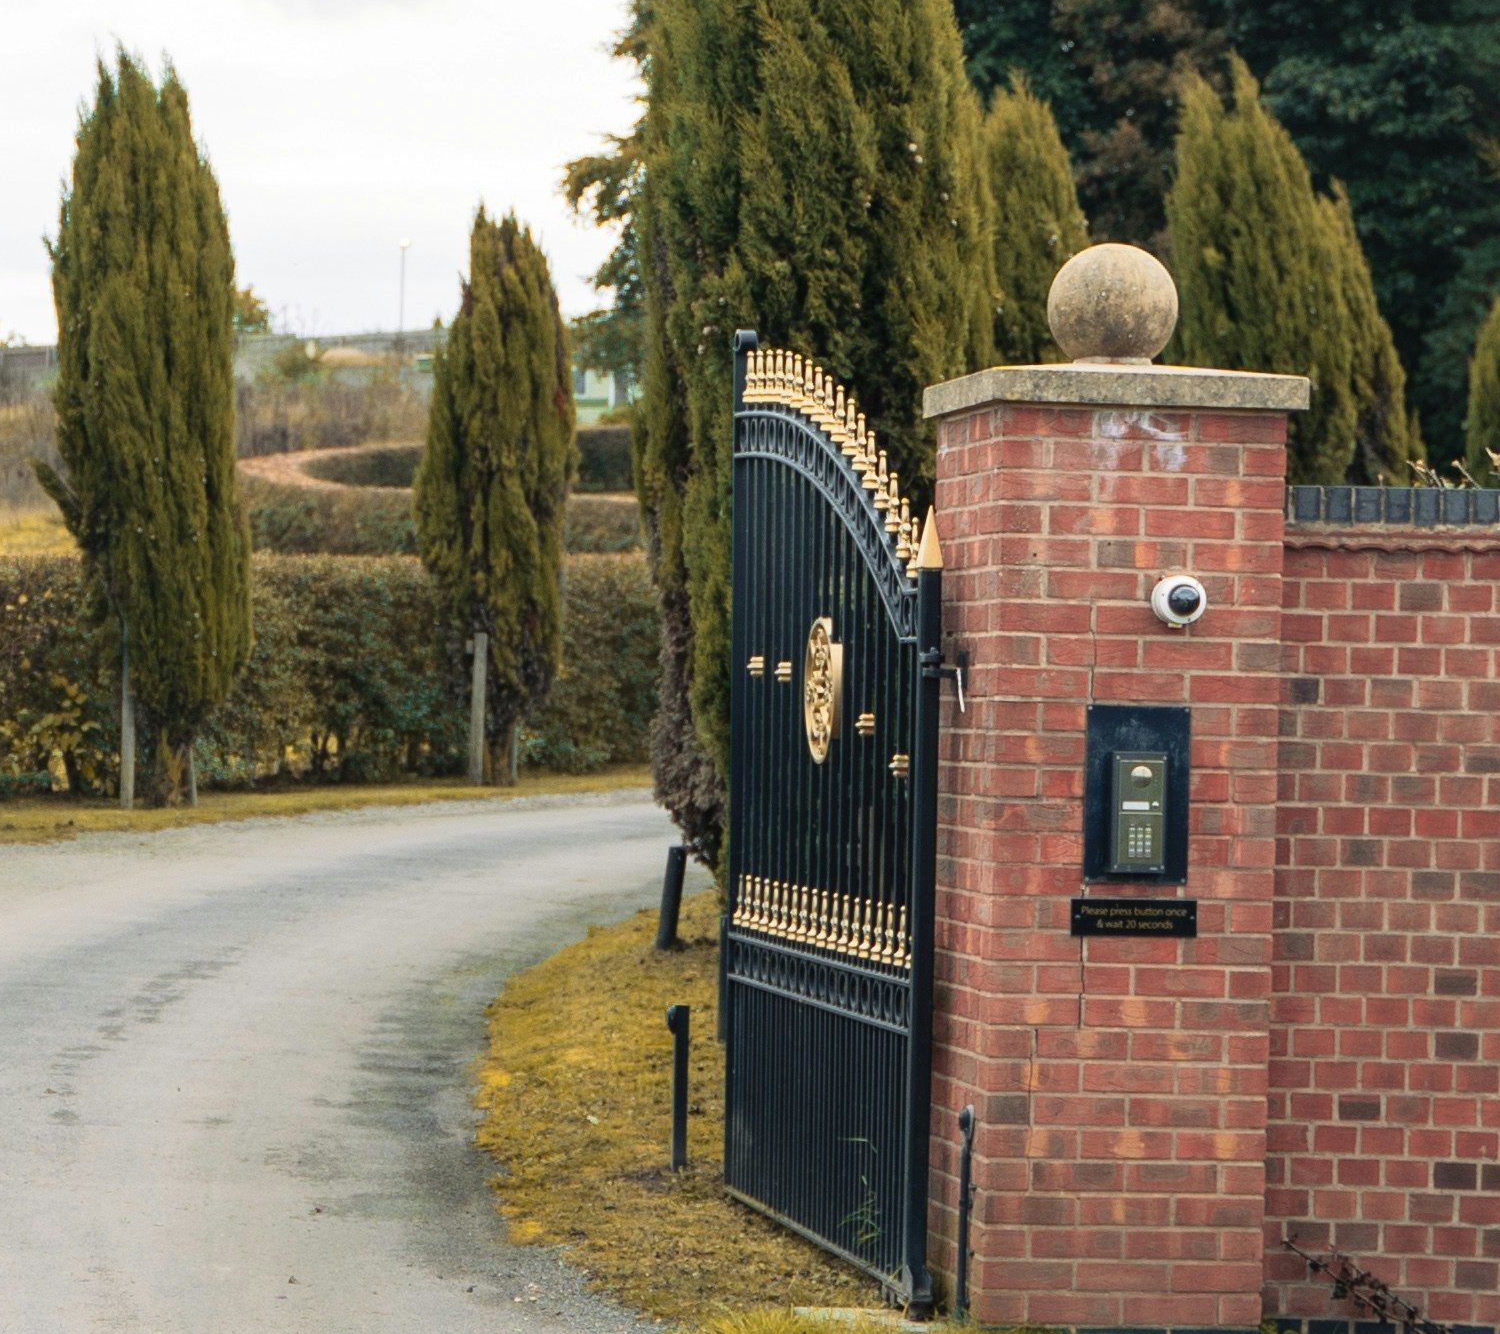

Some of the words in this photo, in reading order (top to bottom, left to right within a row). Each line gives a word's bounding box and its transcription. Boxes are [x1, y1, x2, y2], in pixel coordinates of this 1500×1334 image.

[1080, 905, 1108, 916] Please
[1109, 907, 1132, 917] press
[1134, 907, 1163, 916] button
[1165, 908, 1188, 917] once
[1105, 919, 1123, 929] wait
[1138, 919, 1174, 930] seconds
